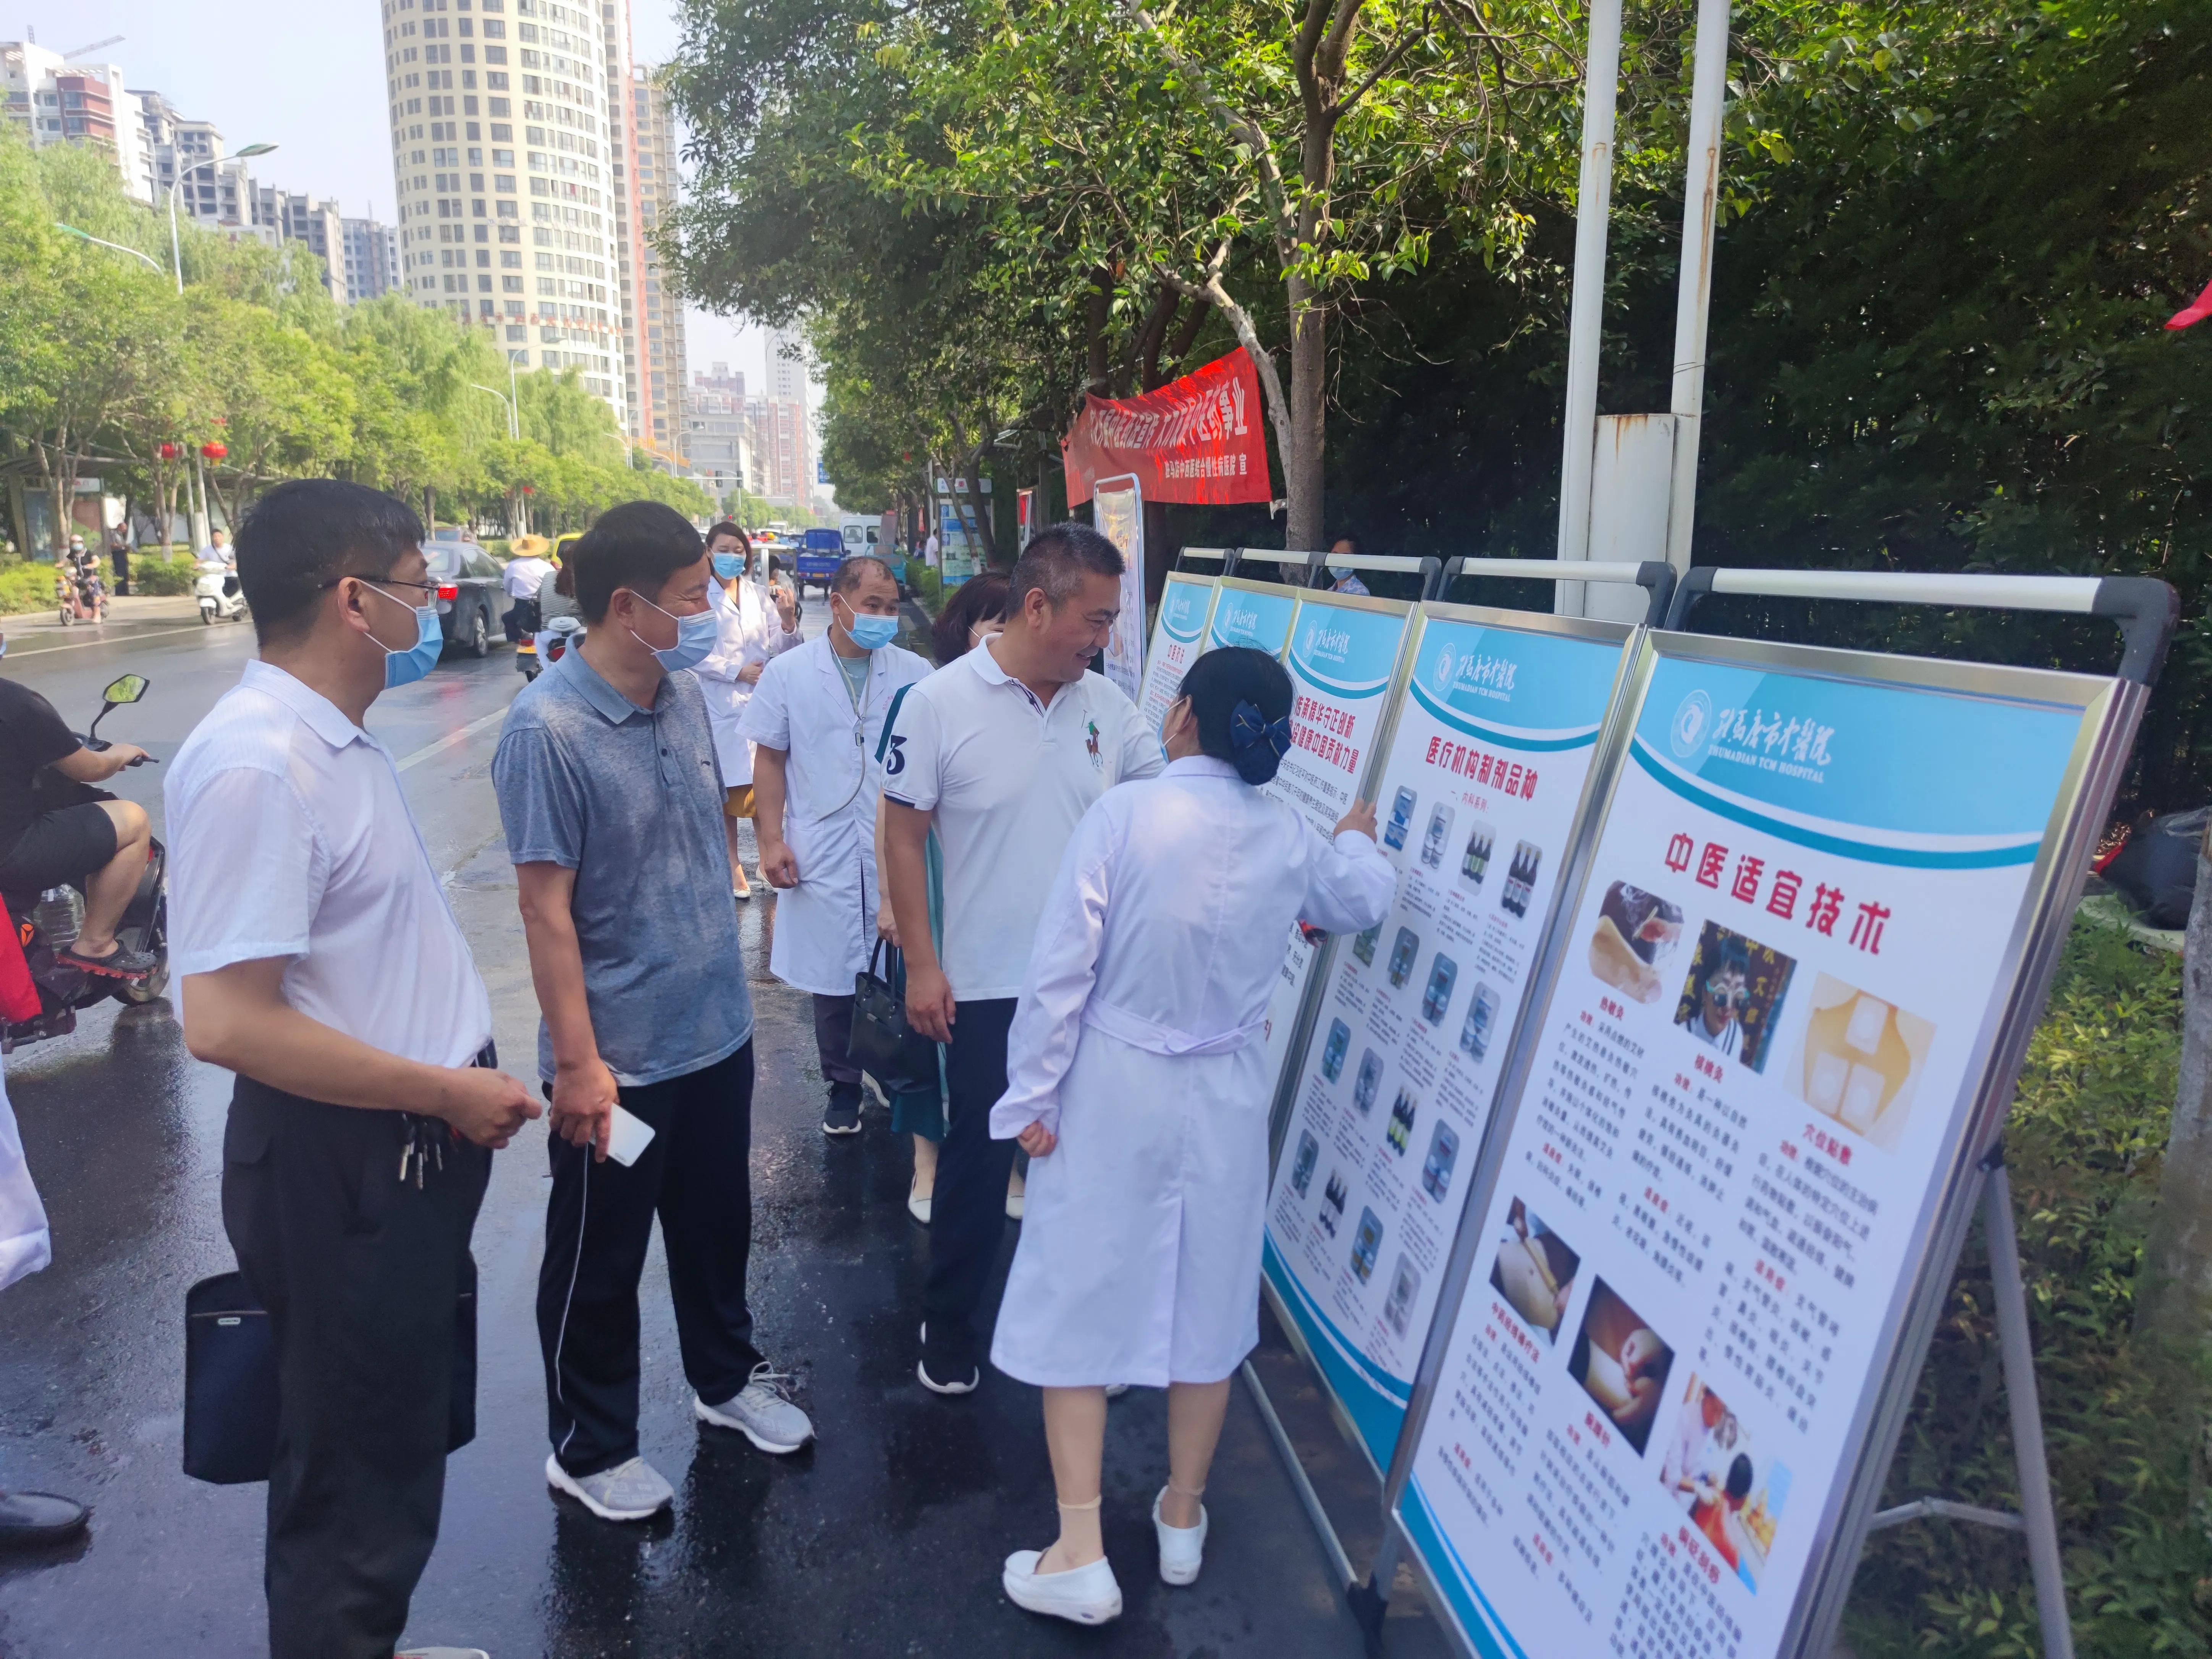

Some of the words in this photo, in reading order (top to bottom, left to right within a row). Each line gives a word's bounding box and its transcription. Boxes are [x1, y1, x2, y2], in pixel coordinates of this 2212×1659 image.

[1239, 452, 1247, 475] 宣
[1453, 681, 1478, 694] ZHUMADIAN
[1479, 687, 1488, 696] TCM
[1488, 689, 1510, 702] HOSPITAL
[1295, 695, 1355, 739] 传承精华守正创新
[886, 735, 907, 775] 3
[1289, 720, 1359, 774] 设健康中国贡献力量
[1708, 744, 1756, 766] ZHUMADIAN
[1759, 756, 1777, 771] TCM
[1779, 762, 1824, 783] HOSPITAL
[1426, 736, 1538, 802] 医疗机构制剂品种
[1664, 832, 1891, 955] 中医适宜技术
